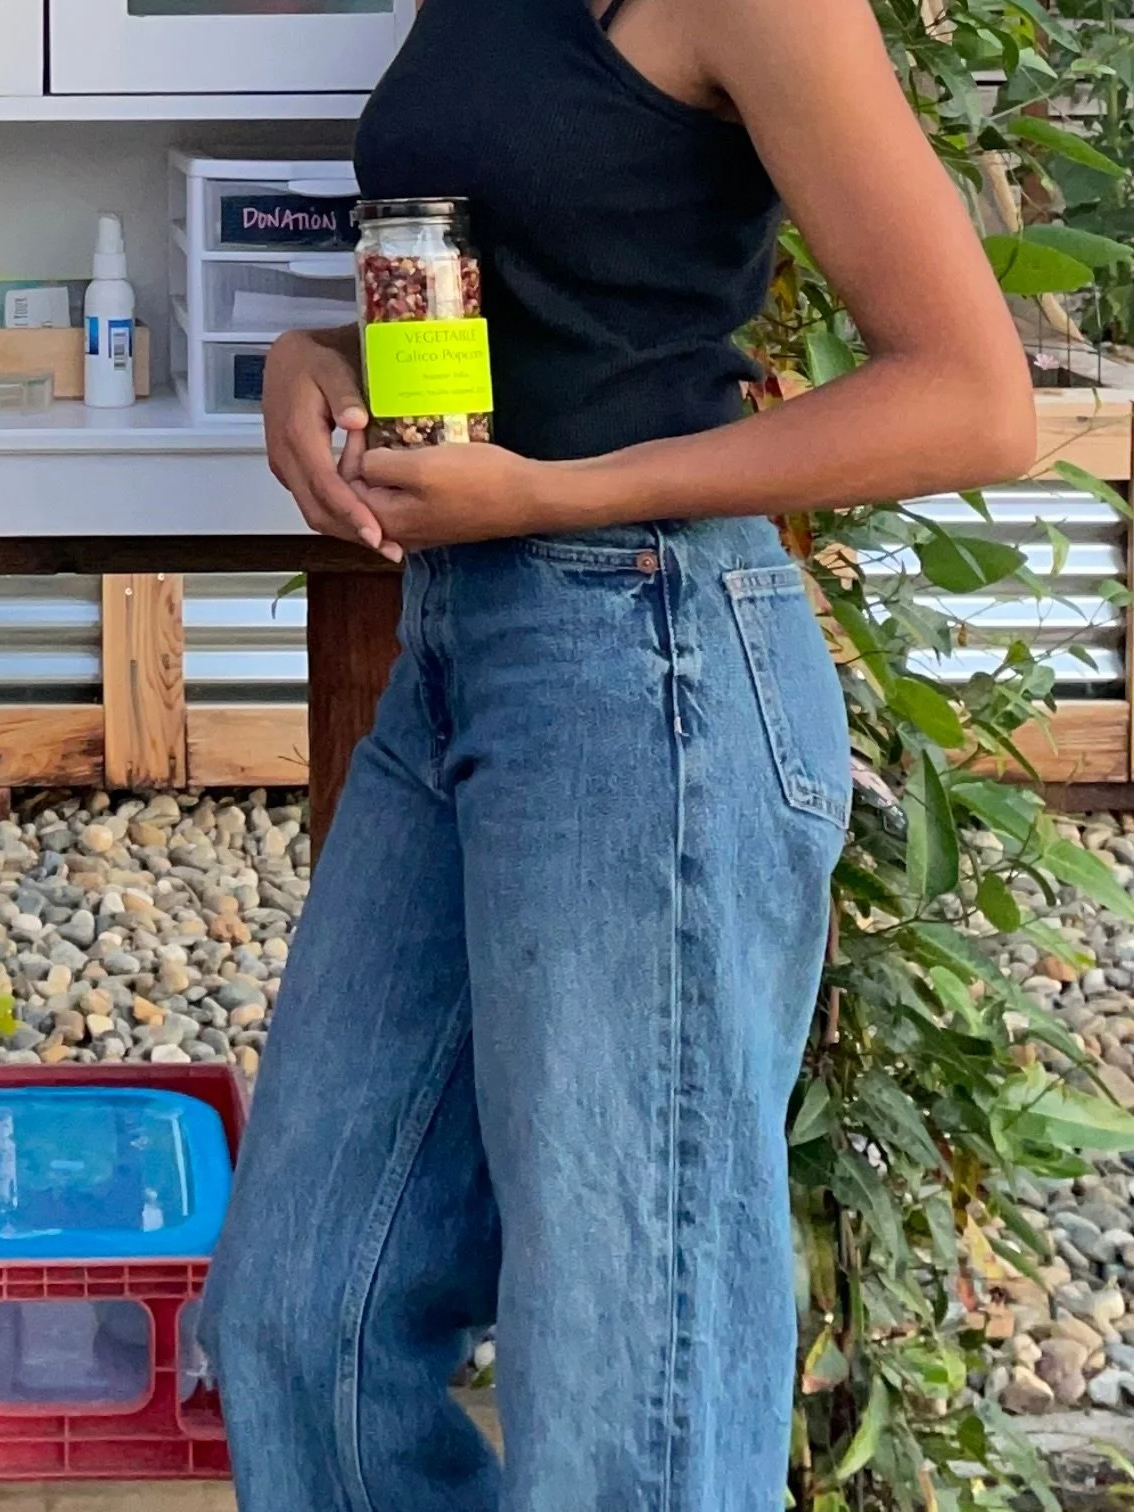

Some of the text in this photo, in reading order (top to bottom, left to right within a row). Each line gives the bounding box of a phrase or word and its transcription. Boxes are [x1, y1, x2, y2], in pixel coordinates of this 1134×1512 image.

[242, 205, 337, 232] DONATION
[403, 328, 478, 345] VEGETABLE
[395, 349, 439, 364] Calico
